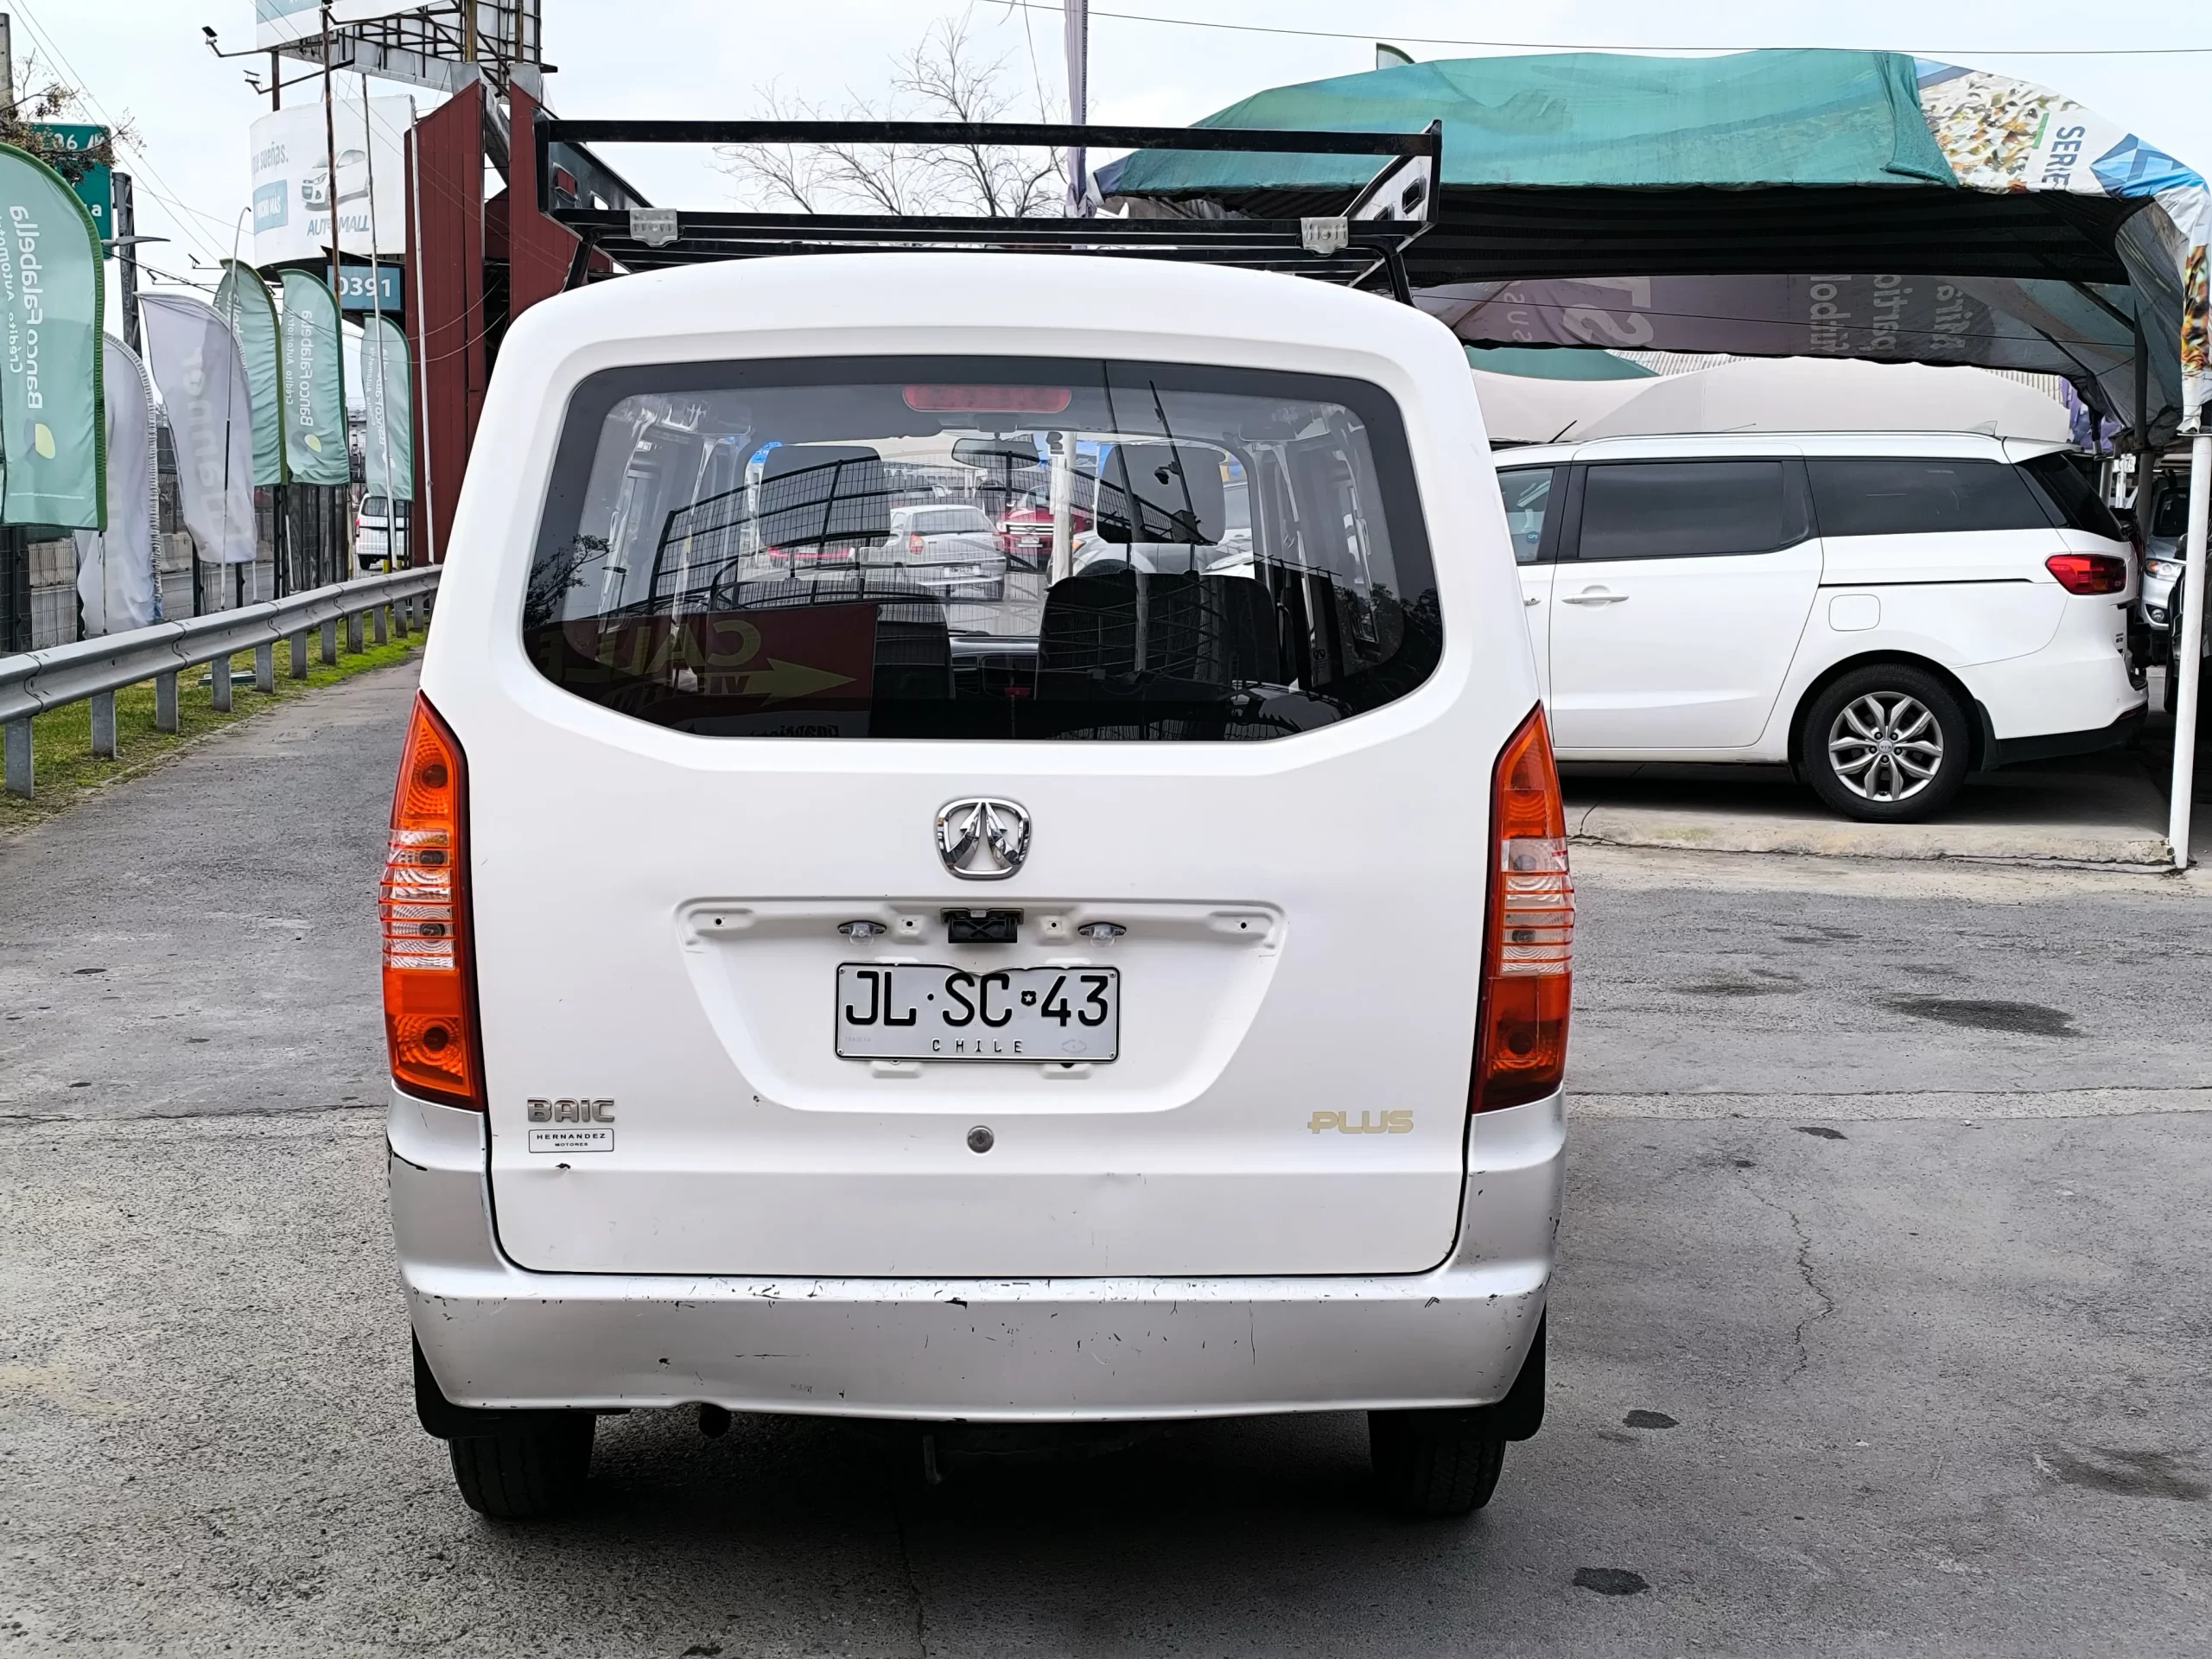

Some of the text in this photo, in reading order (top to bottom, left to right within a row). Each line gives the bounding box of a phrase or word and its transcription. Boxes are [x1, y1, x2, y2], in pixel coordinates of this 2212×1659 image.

[932, 1039, 1023, 1053] CHILE
[527, 1097, 615, 1122] BAIC
[1307, 1110, 1414, 1135] PLUS
